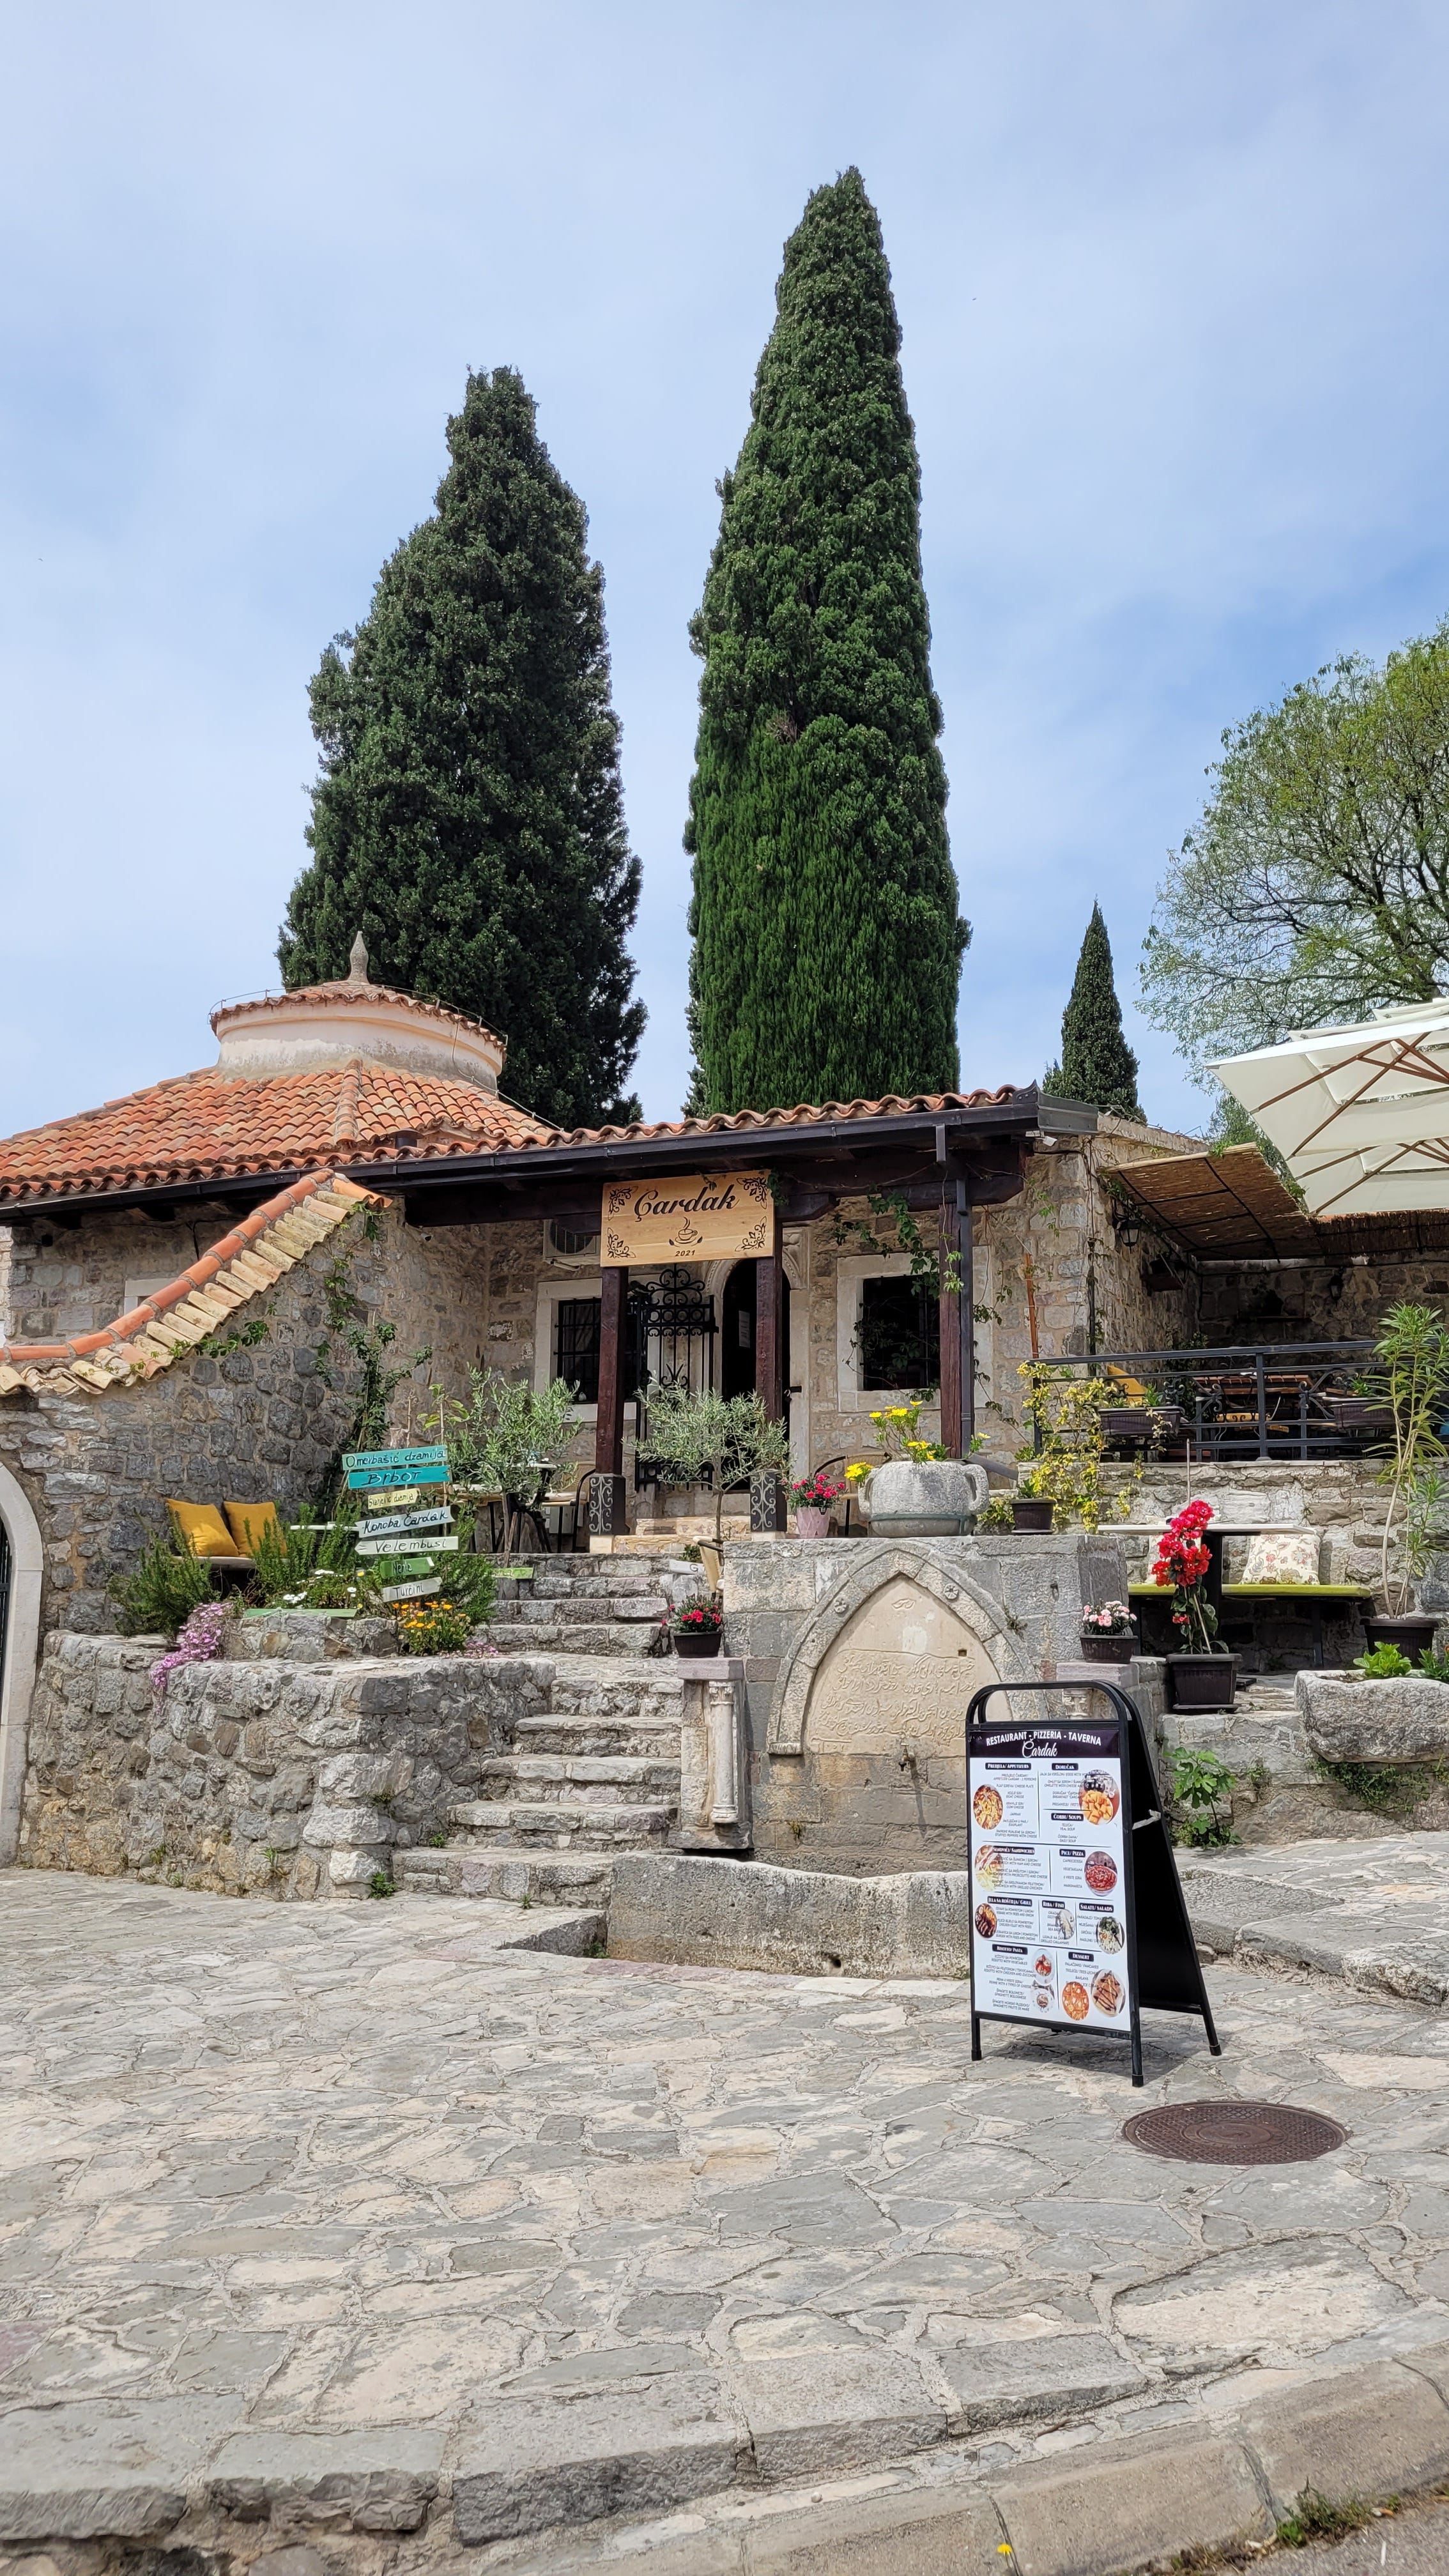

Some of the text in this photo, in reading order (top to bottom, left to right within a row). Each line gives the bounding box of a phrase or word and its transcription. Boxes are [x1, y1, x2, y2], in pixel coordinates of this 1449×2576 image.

[634, 1184, 740, 1222] Çardak
[364, 1518, 400, 1534] Konoba
[986, 1731, 1027, 1746] RESTAURANT
[1068, 1732, 1101, 1745] TAVERNA
[1022, 1738, 1057, 1758] Čardak
